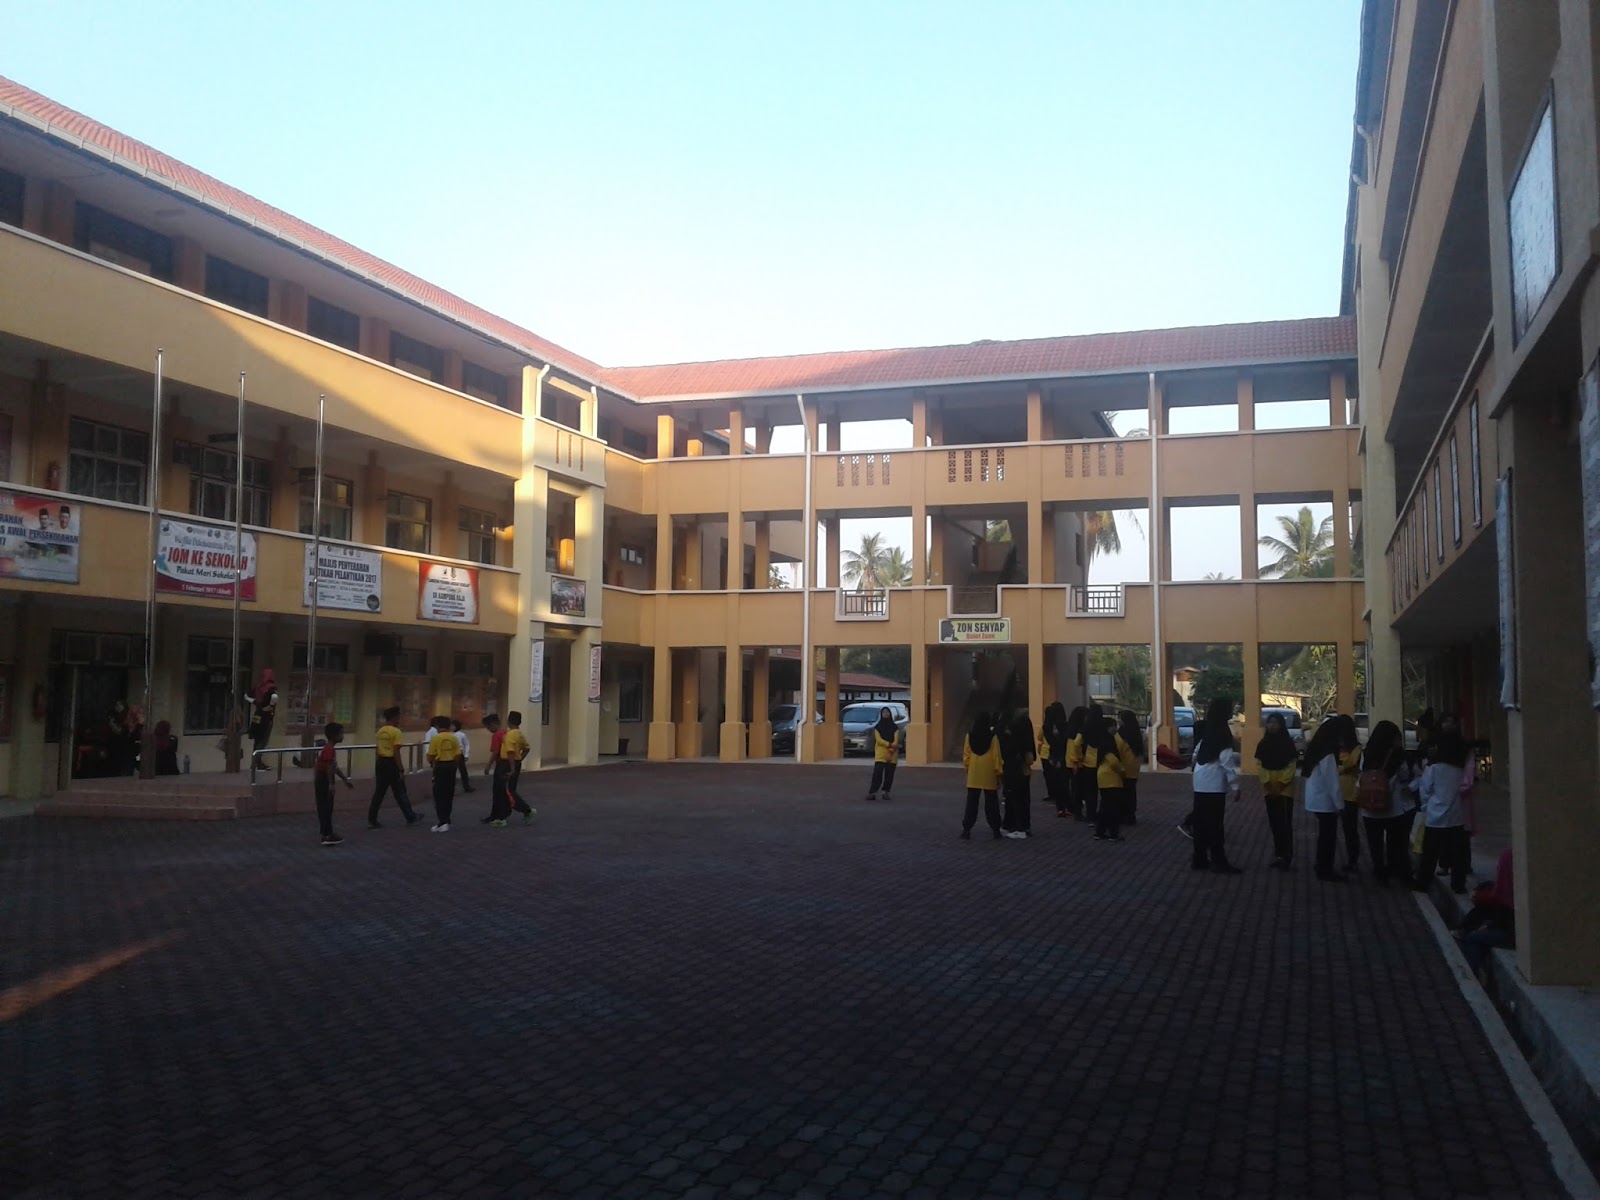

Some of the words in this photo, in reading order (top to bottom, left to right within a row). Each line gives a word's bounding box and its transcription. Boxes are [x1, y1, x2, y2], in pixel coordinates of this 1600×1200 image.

[168, 547, 190, 563] JOM
[192, 550, 203, 566] KE
[205, 552, 248, 570] SEKOLH
[957, 622, 973, 633] ZON
[975, 622, 1005, 633] SENYAP
